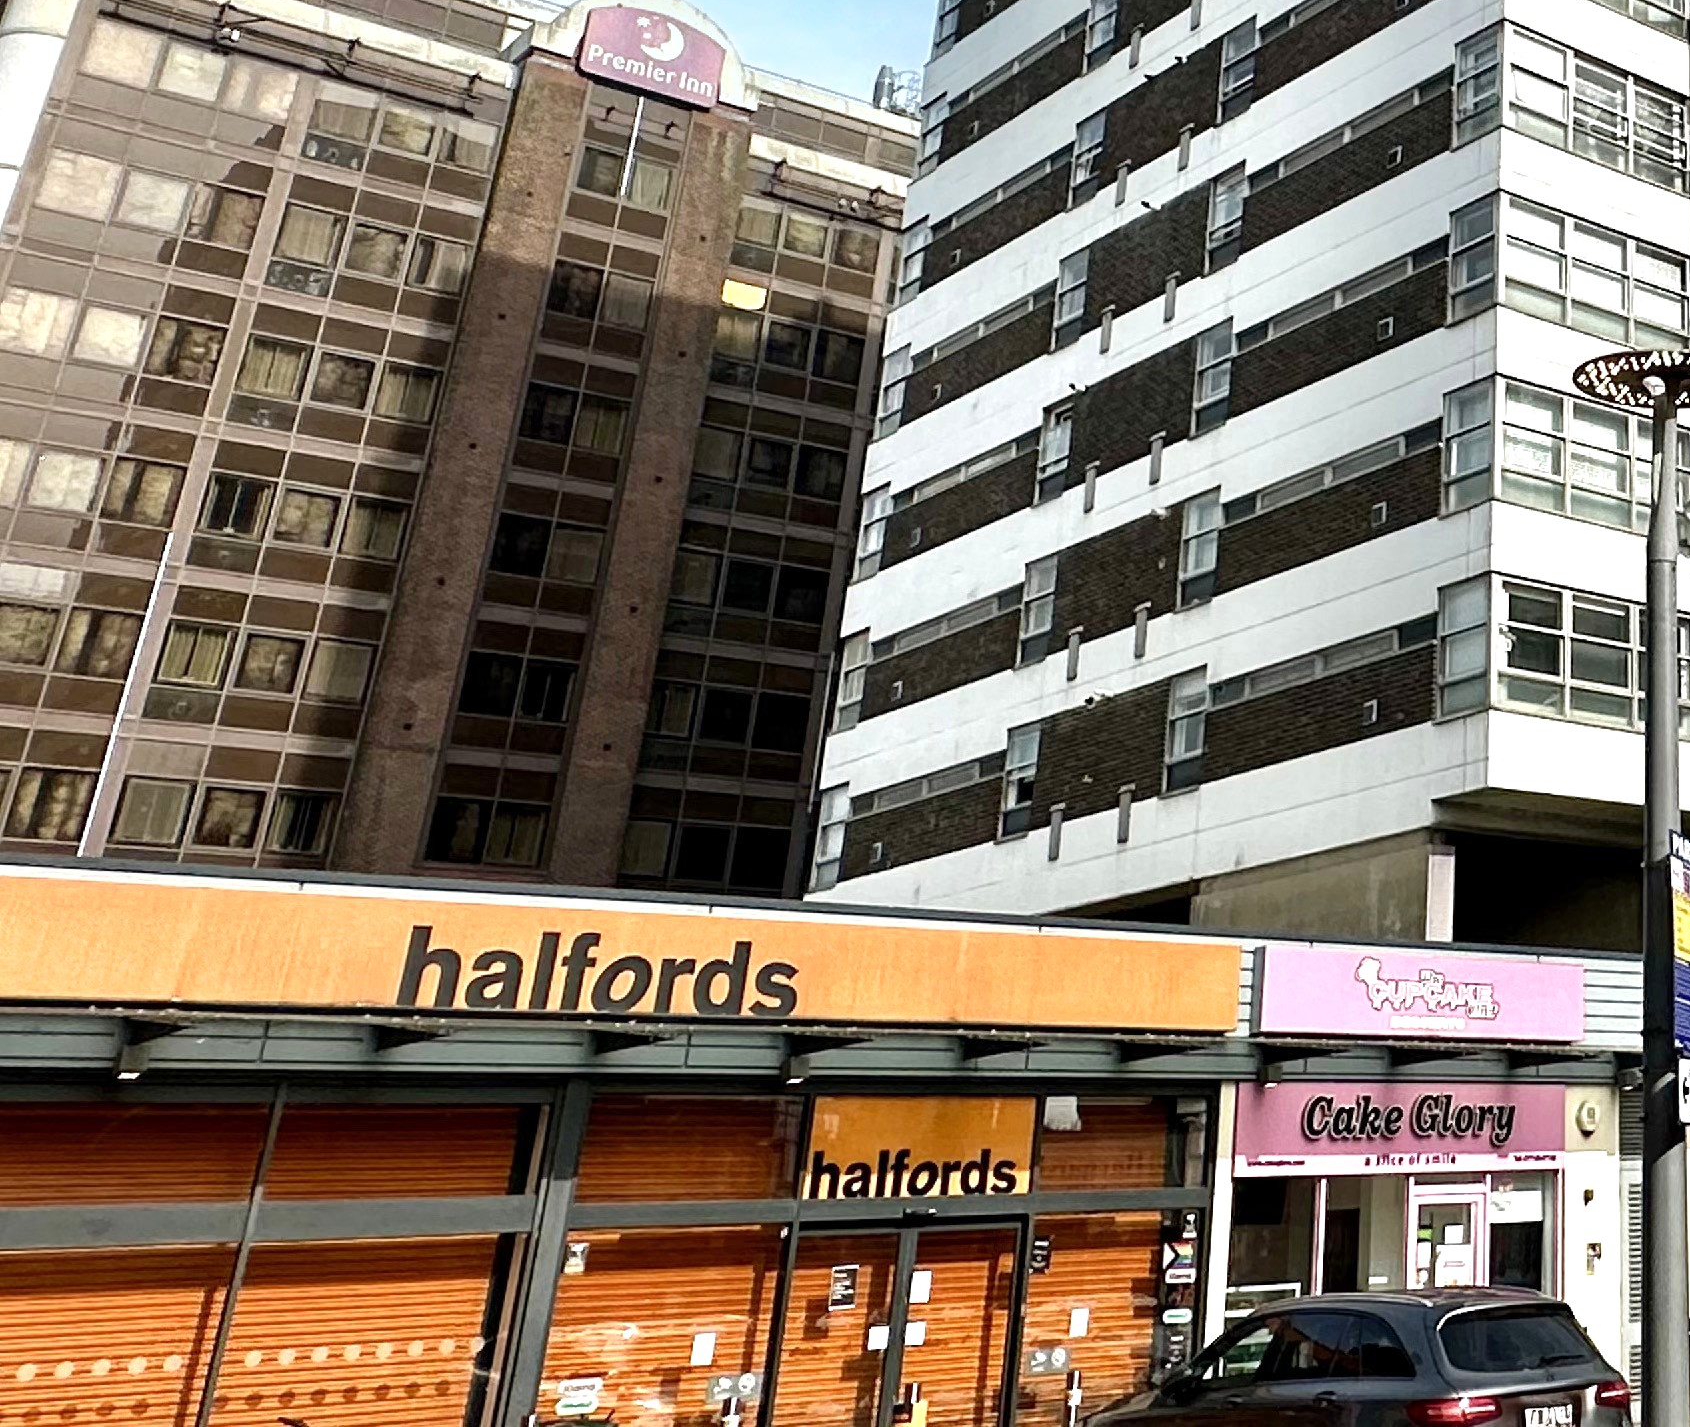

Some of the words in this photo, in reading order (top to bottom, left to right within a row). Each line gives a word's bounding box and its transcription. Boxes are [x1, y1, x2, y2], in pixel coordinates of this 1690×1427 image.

[588, 44, 677, 84] Premier
[678, 72, 713, 97] Inn
[396, 925, 799, 1017] halfords
[1304, 1095, 1403, 1139] Cake
[1414, 1093, 1516, 1147] Glory
[809, 1149, 1018, 1200] halfords
